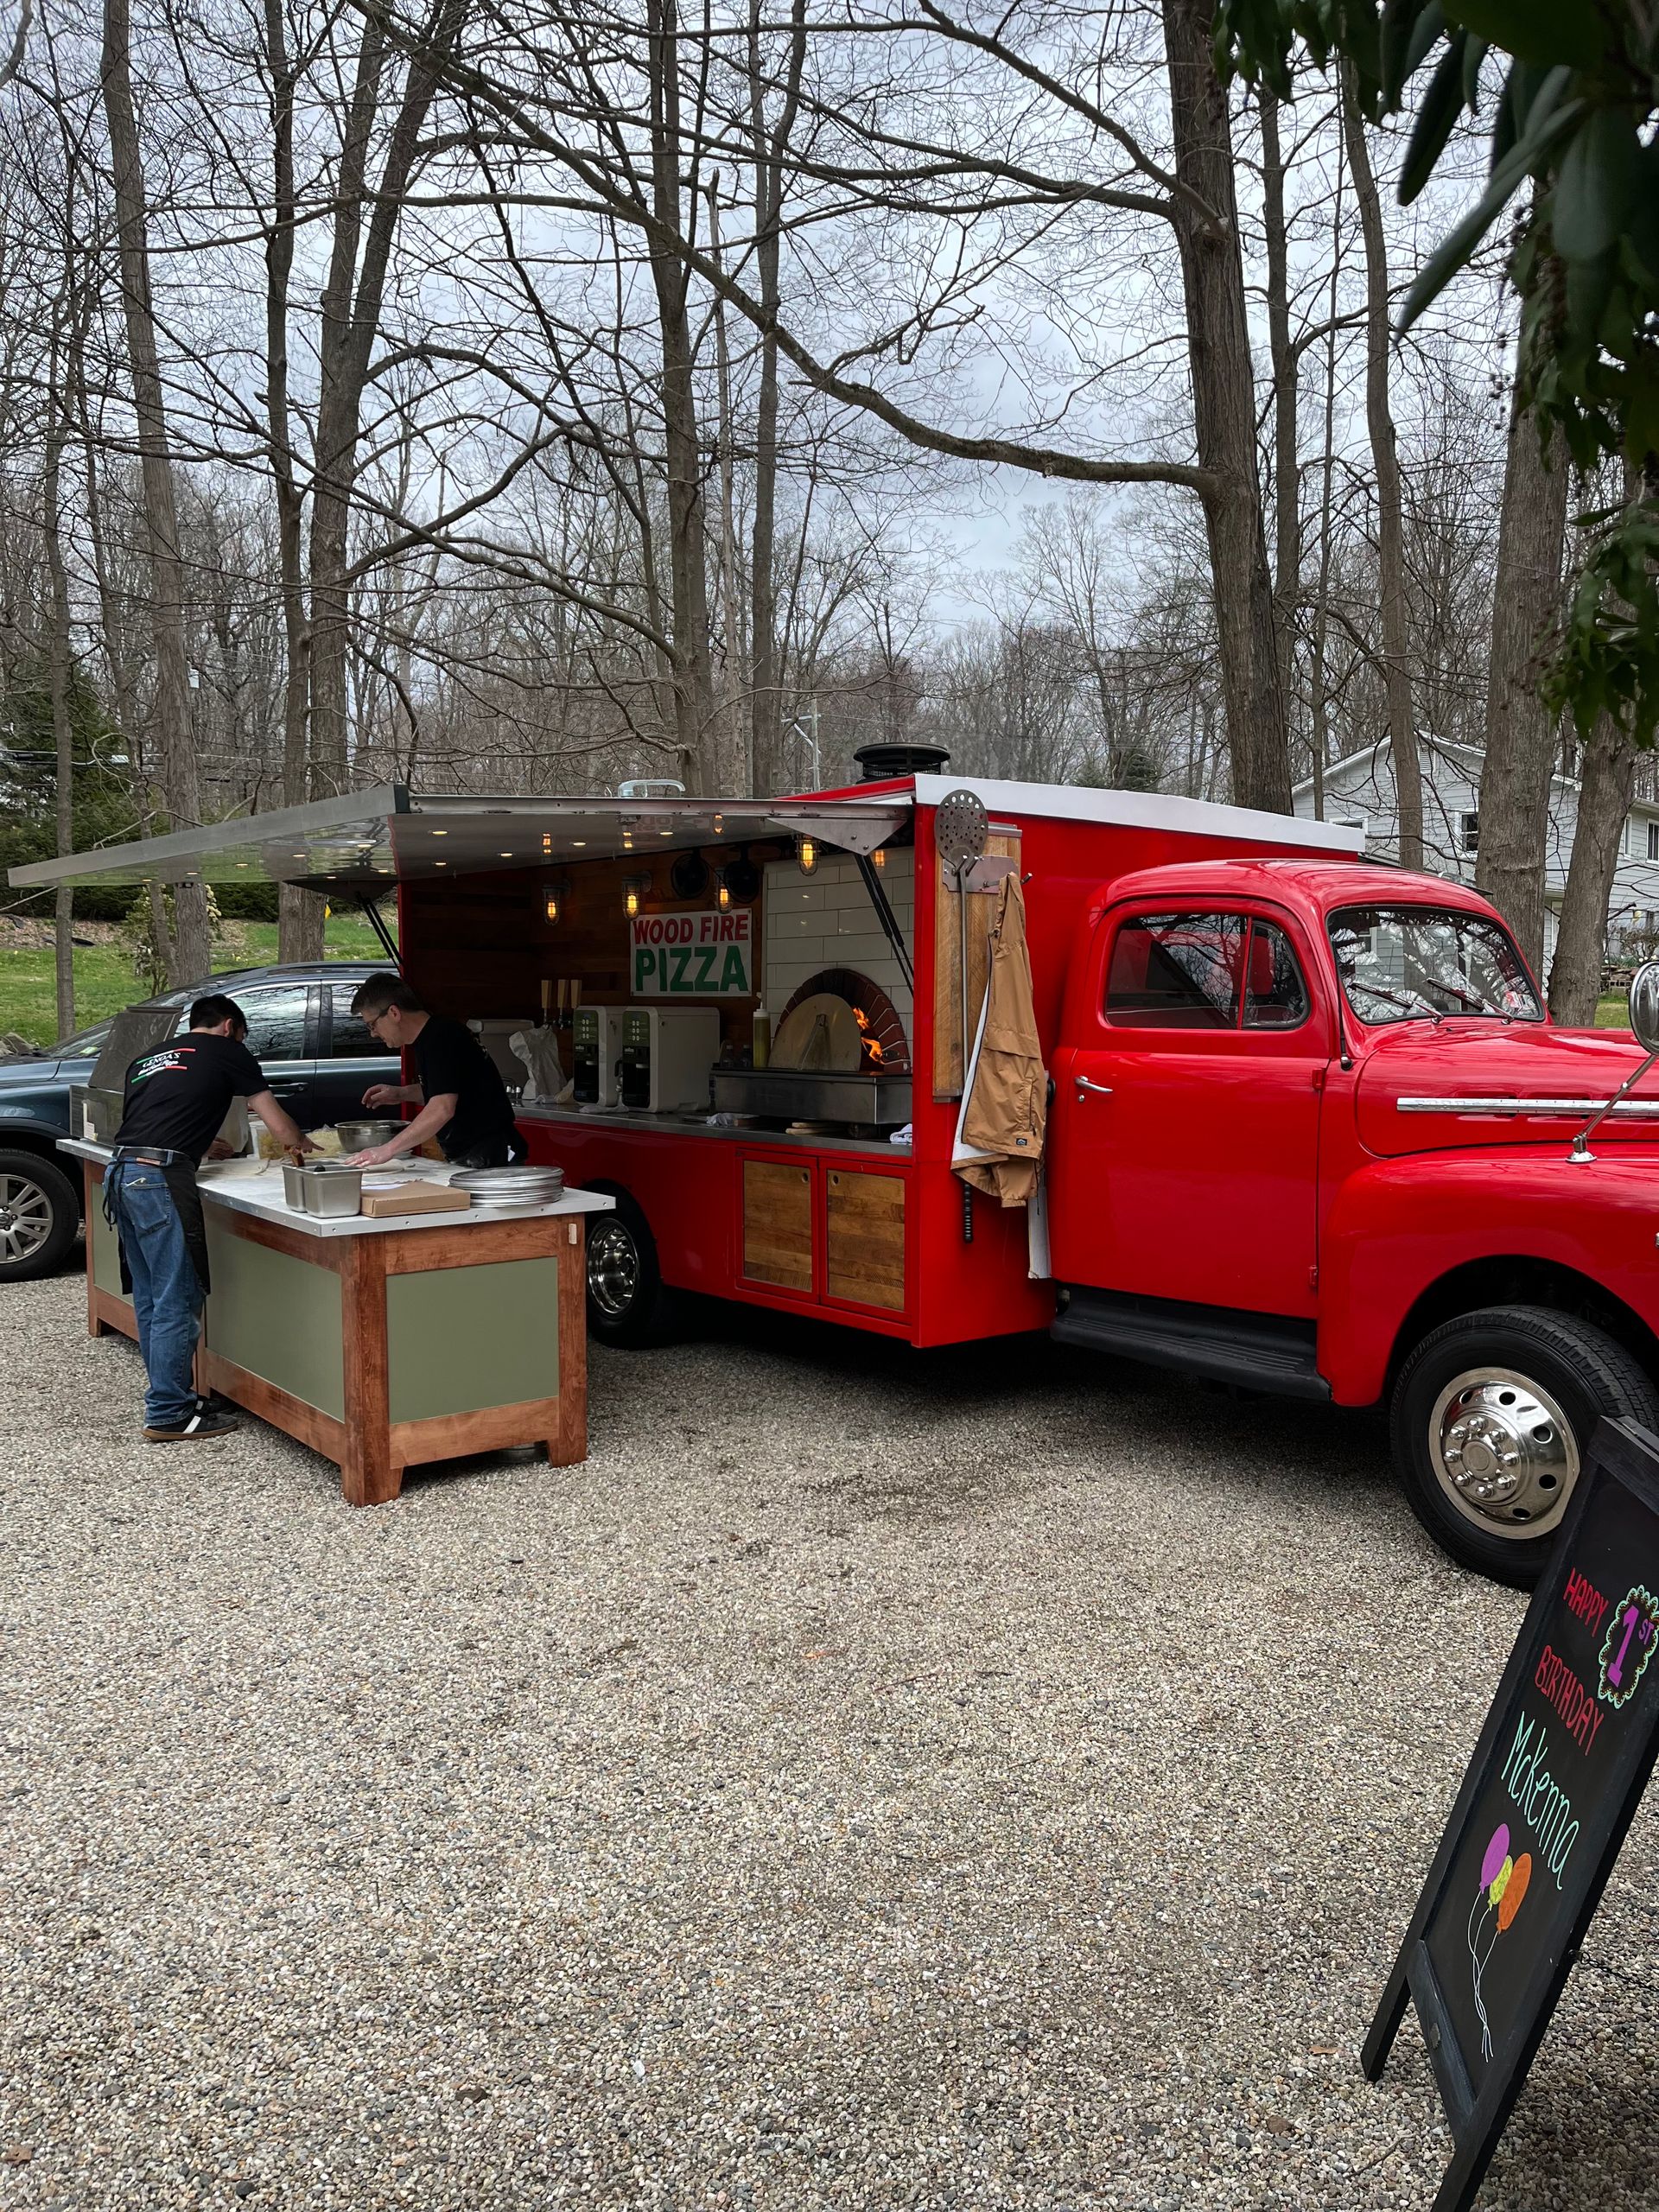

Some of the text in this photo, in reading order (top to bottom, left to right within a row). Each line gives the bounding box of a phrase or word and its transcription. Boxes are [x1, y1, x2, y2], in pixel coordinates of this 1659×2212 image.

[633, 914, 749, 944] WOOD FIRE
[635, 945, 749, 992] PIZZA
[1563, 1567, 1610, 1638] HAPPY
[1535, 1644, 1605, 1757] BIRTHDAY
